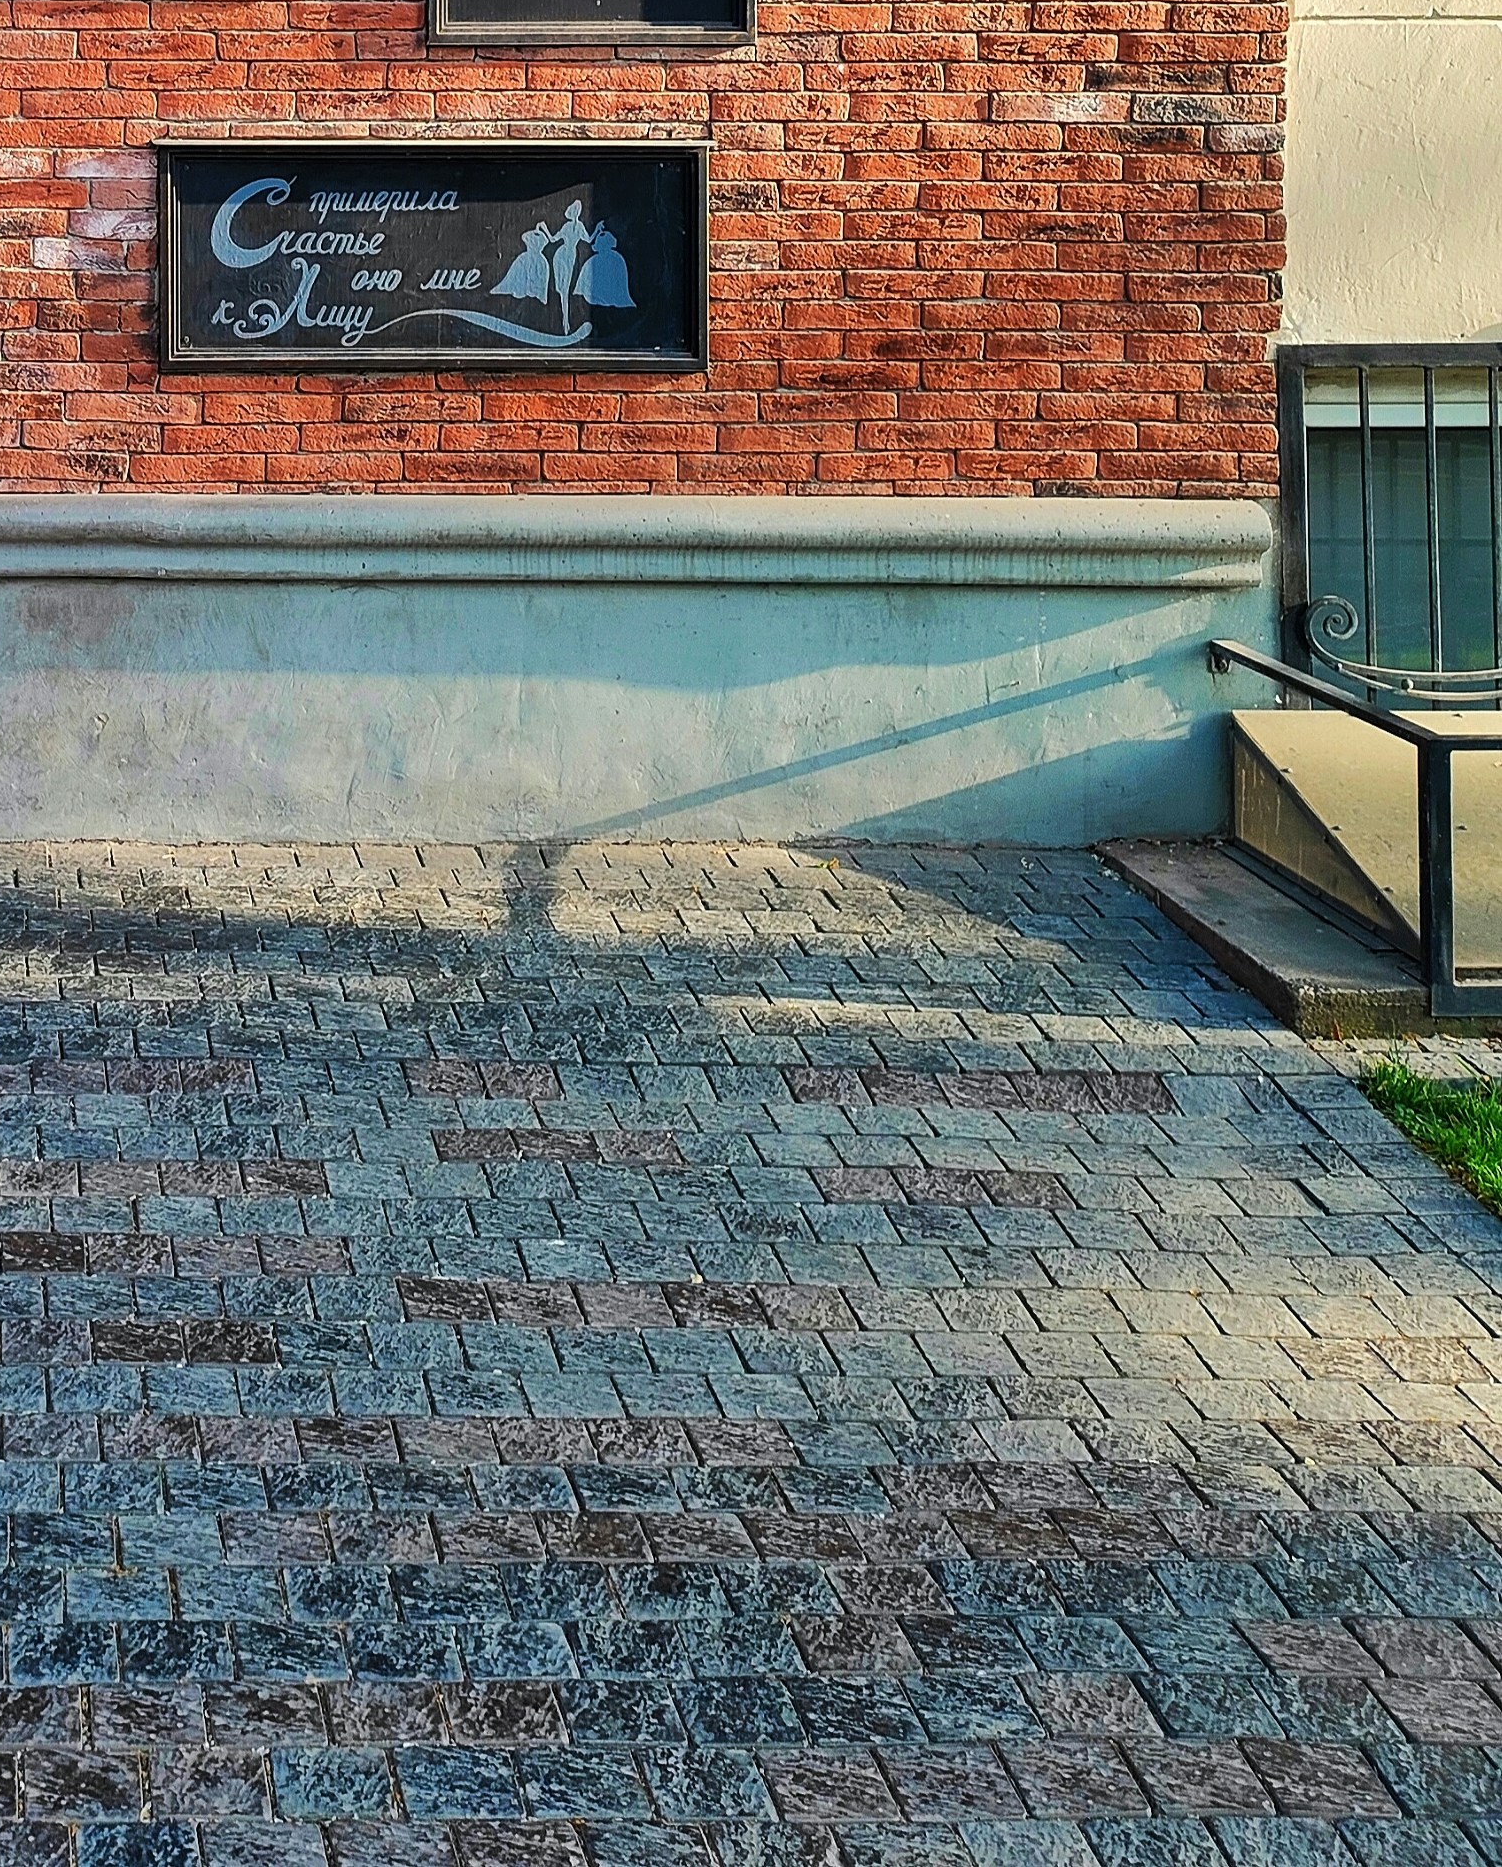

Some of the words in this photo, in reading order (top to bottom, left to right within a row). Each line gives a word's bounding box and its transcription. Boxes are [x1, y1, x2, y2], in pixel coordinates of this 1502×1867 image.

[210, 176, 386, 269] Счастье
[309, 190, 460, 225] примерила
[351, 269, 403, 292] оно
[420, 268, 483, 291] мне
[212, 299, 236, 325] к
